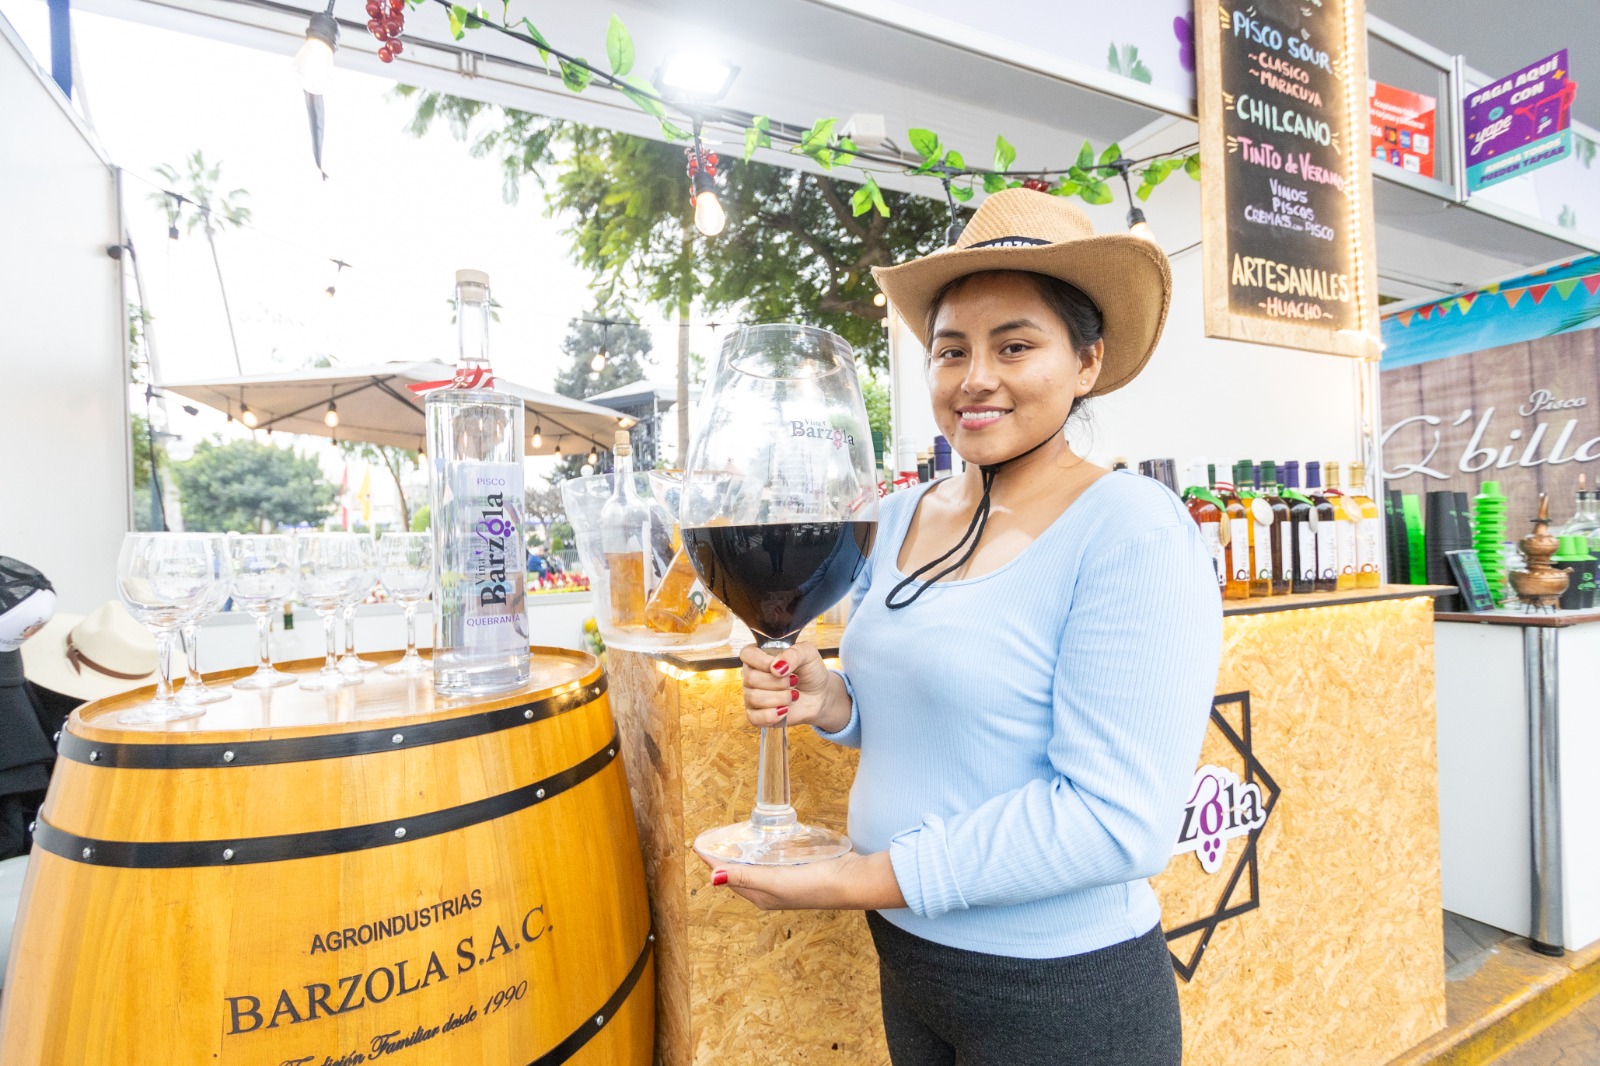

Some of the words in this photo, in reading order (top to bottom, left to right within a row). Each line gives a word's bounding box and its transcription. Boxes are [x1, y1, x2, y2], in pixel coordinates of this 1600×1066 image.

[1233, 10, 1283, 51] PISCO
[1287, 36, 1333, 75] SOUR
[1471, 79, 1513, 108] PAGA
[1514, 54, 1560, 88] AQUÍ
[1509, 80, 1545, 106] CON
[1236, 94, 1331, 146] CHILCANO
[1470, 114, 1513, 156] yape
[1269, 177, 1308, 204] VINOS
[1284, 152, 1299, 174] de
[1299, 152, 1345, 192] VERANO
[1244, 204, 1292, 229] CREMAS
[1304, 221, 1335, 241] PISCO
[1272, 196, 1315, 221] PISCOS
[1231, 252, 1350, 303] ARTESANALES
[790, 420, 855, 449] Barzola
[476, 477, 506, 486] PISCO
[480, 491, 509, 608] Barzola
[466, 615, 520, 627] QUEBRANTA
[1177, 779, 1261, 844] zola
[309, 888, 483, 956] AGROINDUSTRIAS
[224, 950, 449, 1036] BARZOLA
[456, 904, 555, 975] S.A.C.
[368, 1025, 440, 1060] Familiar
[442, 1004, 478, 1034] desde
[483, 980, 528, 1015] 1990
